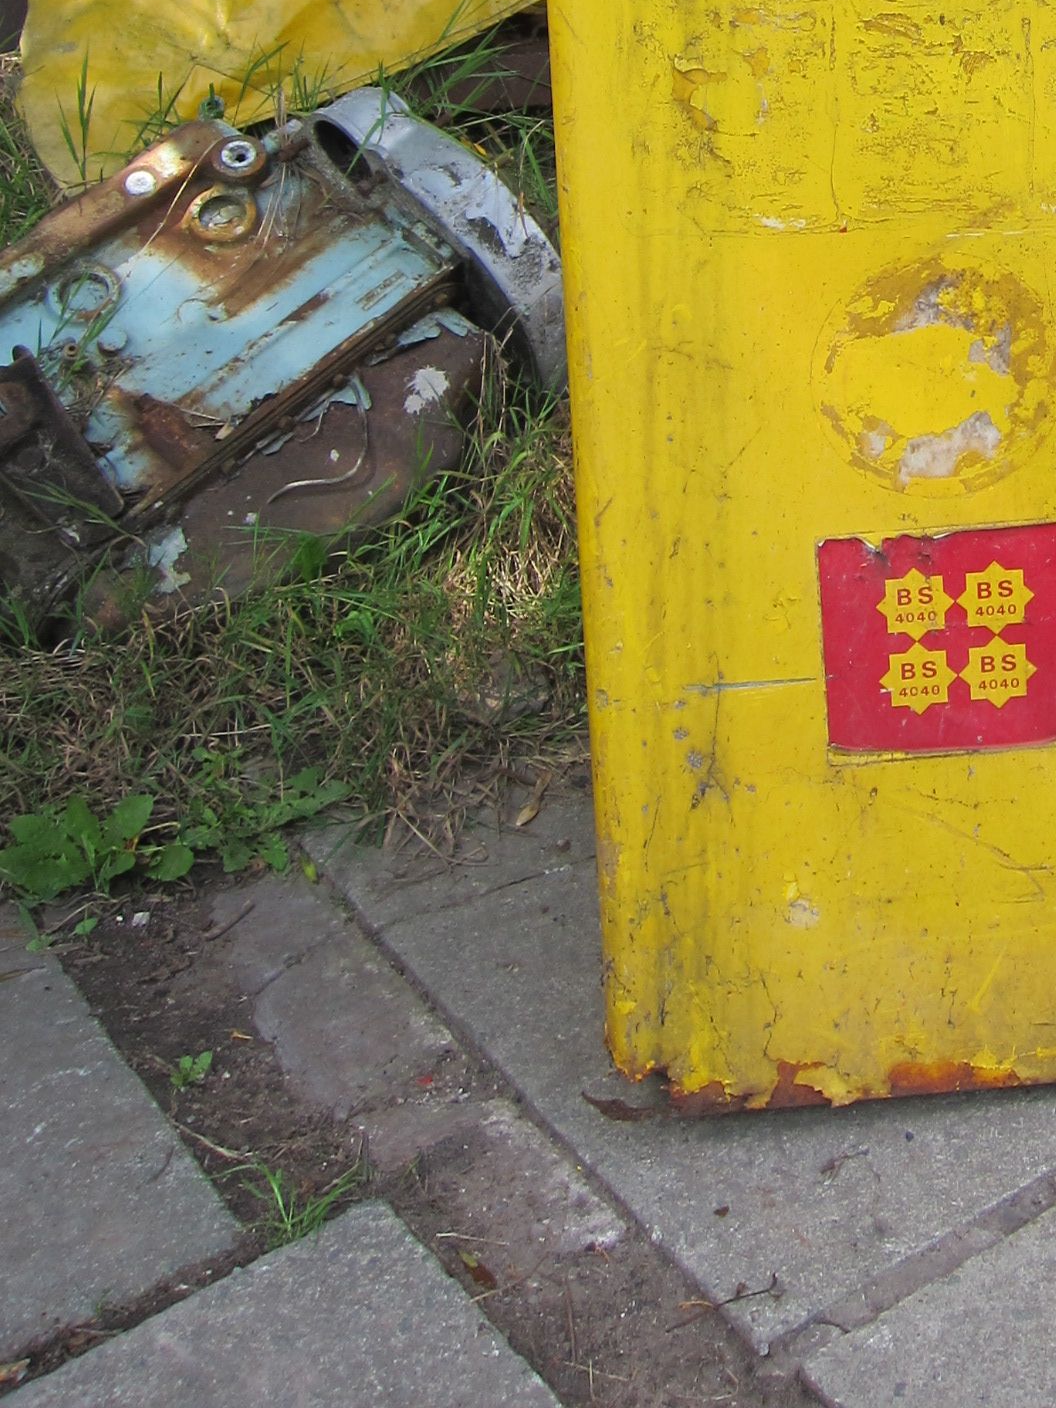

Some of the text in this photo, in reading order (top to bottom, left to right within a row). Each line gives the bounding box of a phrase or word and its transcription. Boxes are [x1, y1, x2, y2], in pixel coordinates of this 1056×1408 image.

[897, 586, 934, 606] BS
[977, 580, 1014, 600] BS
[895, 610, 936, 623] 4040
[975, 604, 1017, 617] 4040
[901, 660, 938, 680] BS
[981, 653, 1017, 673] BS
[899, 685, 940, 697] 4040
[978, 677, 1020, 690] 4040
